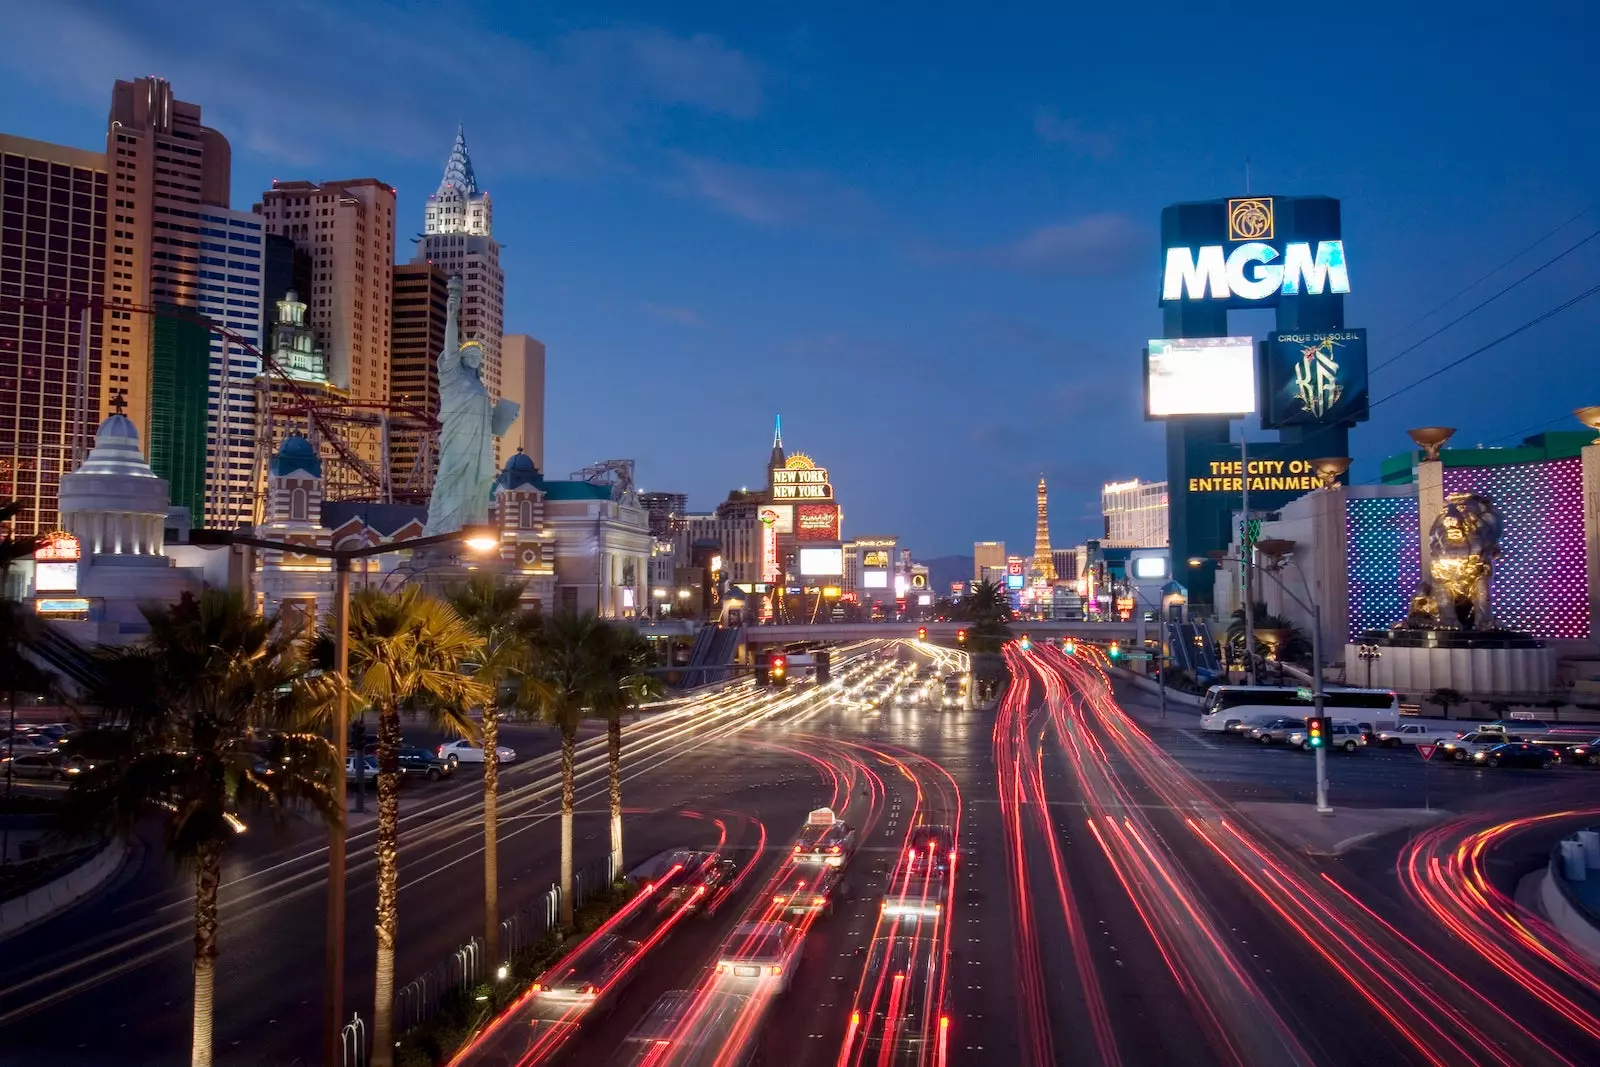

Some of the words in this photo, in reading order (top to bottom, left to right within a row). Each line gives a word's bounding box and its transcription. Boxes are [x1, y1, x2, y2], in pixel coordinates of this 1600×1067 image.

[1162, 240, 1350, 300] MGM
[1278, 334, 1311, 343] CIRQUE
[1313, 333, 1326, 341] DU
[1328, 332, 1359, 340] SOLEIL
[1210, 461, 1242, 475] THE
[1247, 460, 1285, 474] CITY
[773, 470, 797, 483] NEW
[797, 470, 826, 483] YORK
[1189, 476, 1324, 491] ENTERTAINMEN
[773, 485, 797, 498] NEW
[797, 485, 826, 498] YORK
